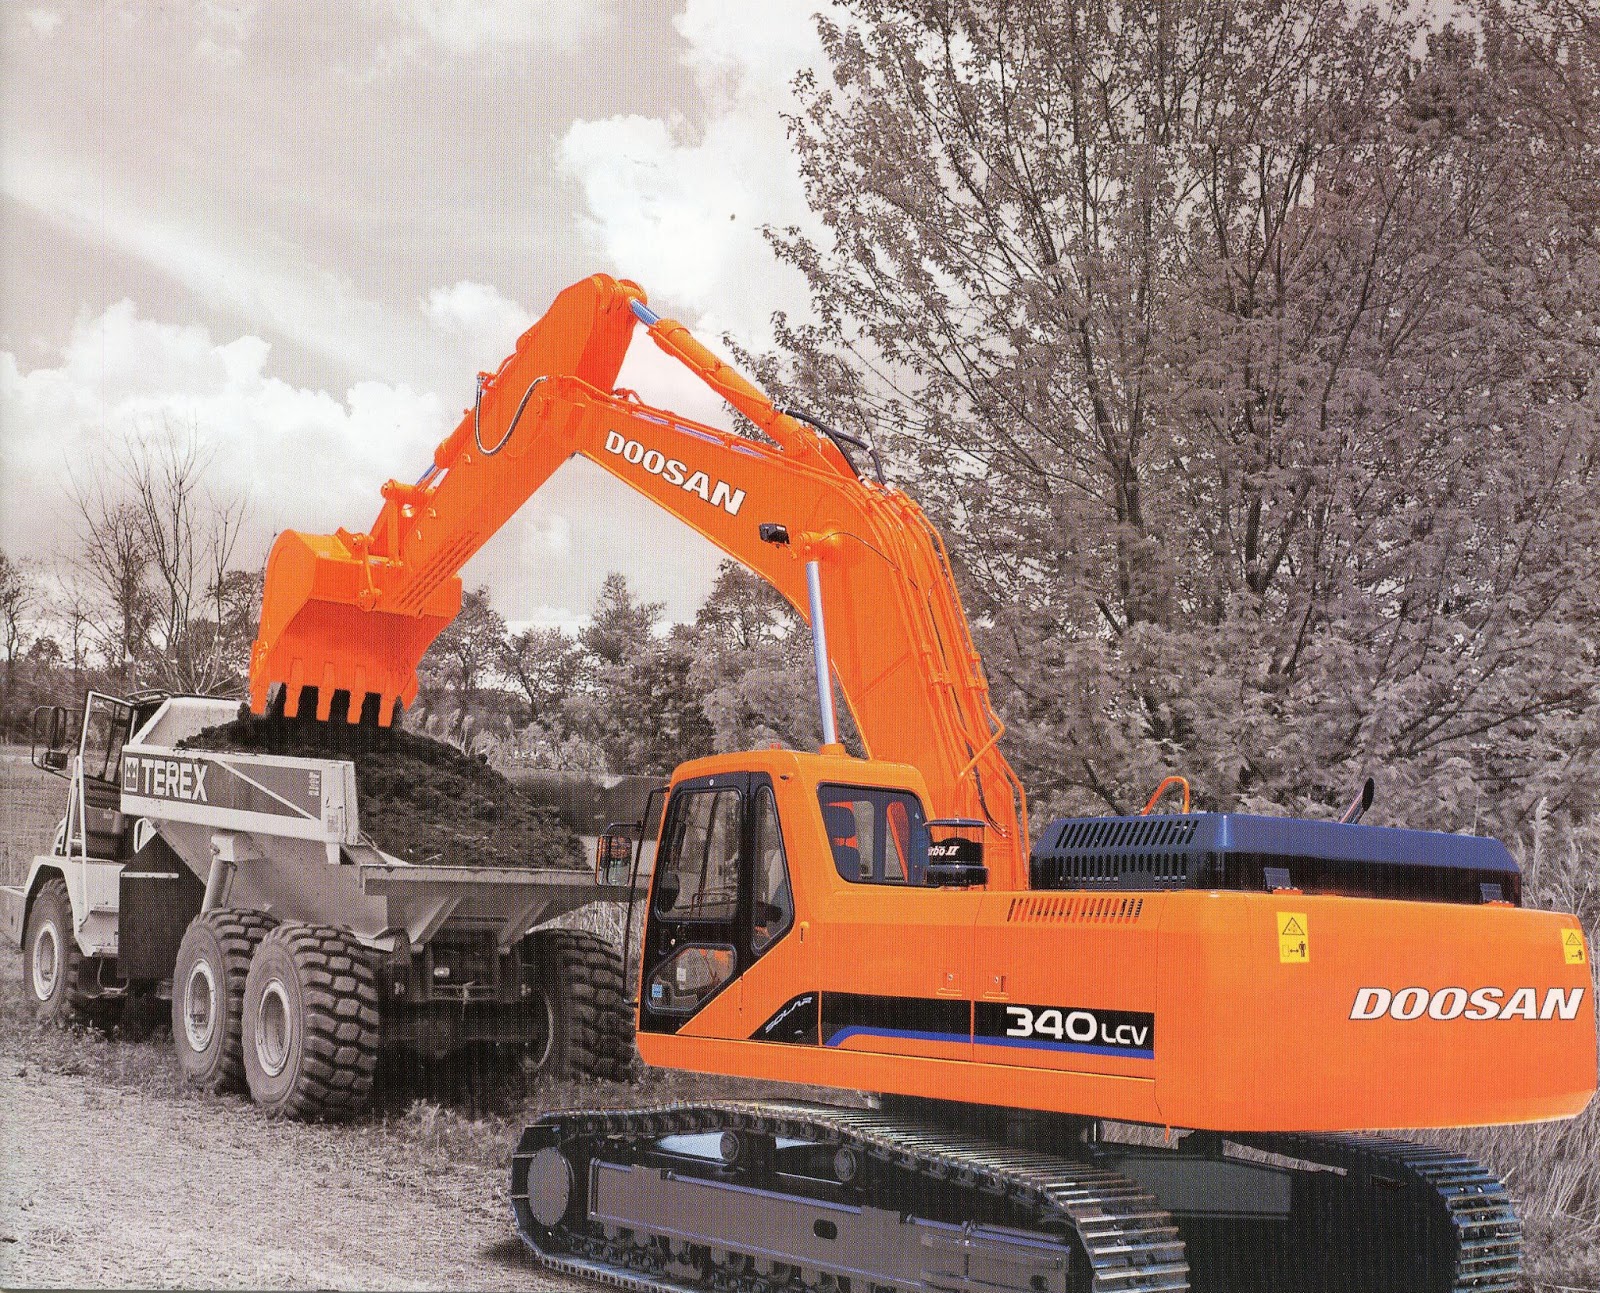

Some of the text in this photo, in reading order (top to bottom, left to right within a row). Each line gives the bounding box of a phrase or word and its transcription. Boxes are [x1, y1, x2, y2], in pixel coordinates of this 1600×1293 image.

[604, 429, 747, 516] DOOSAN
[141, 758, 208, 801] TEREX
[1349, 986, 1586, 1021] DOOSAN
[1006, 1006, 1149, 1046] 340 LCV
